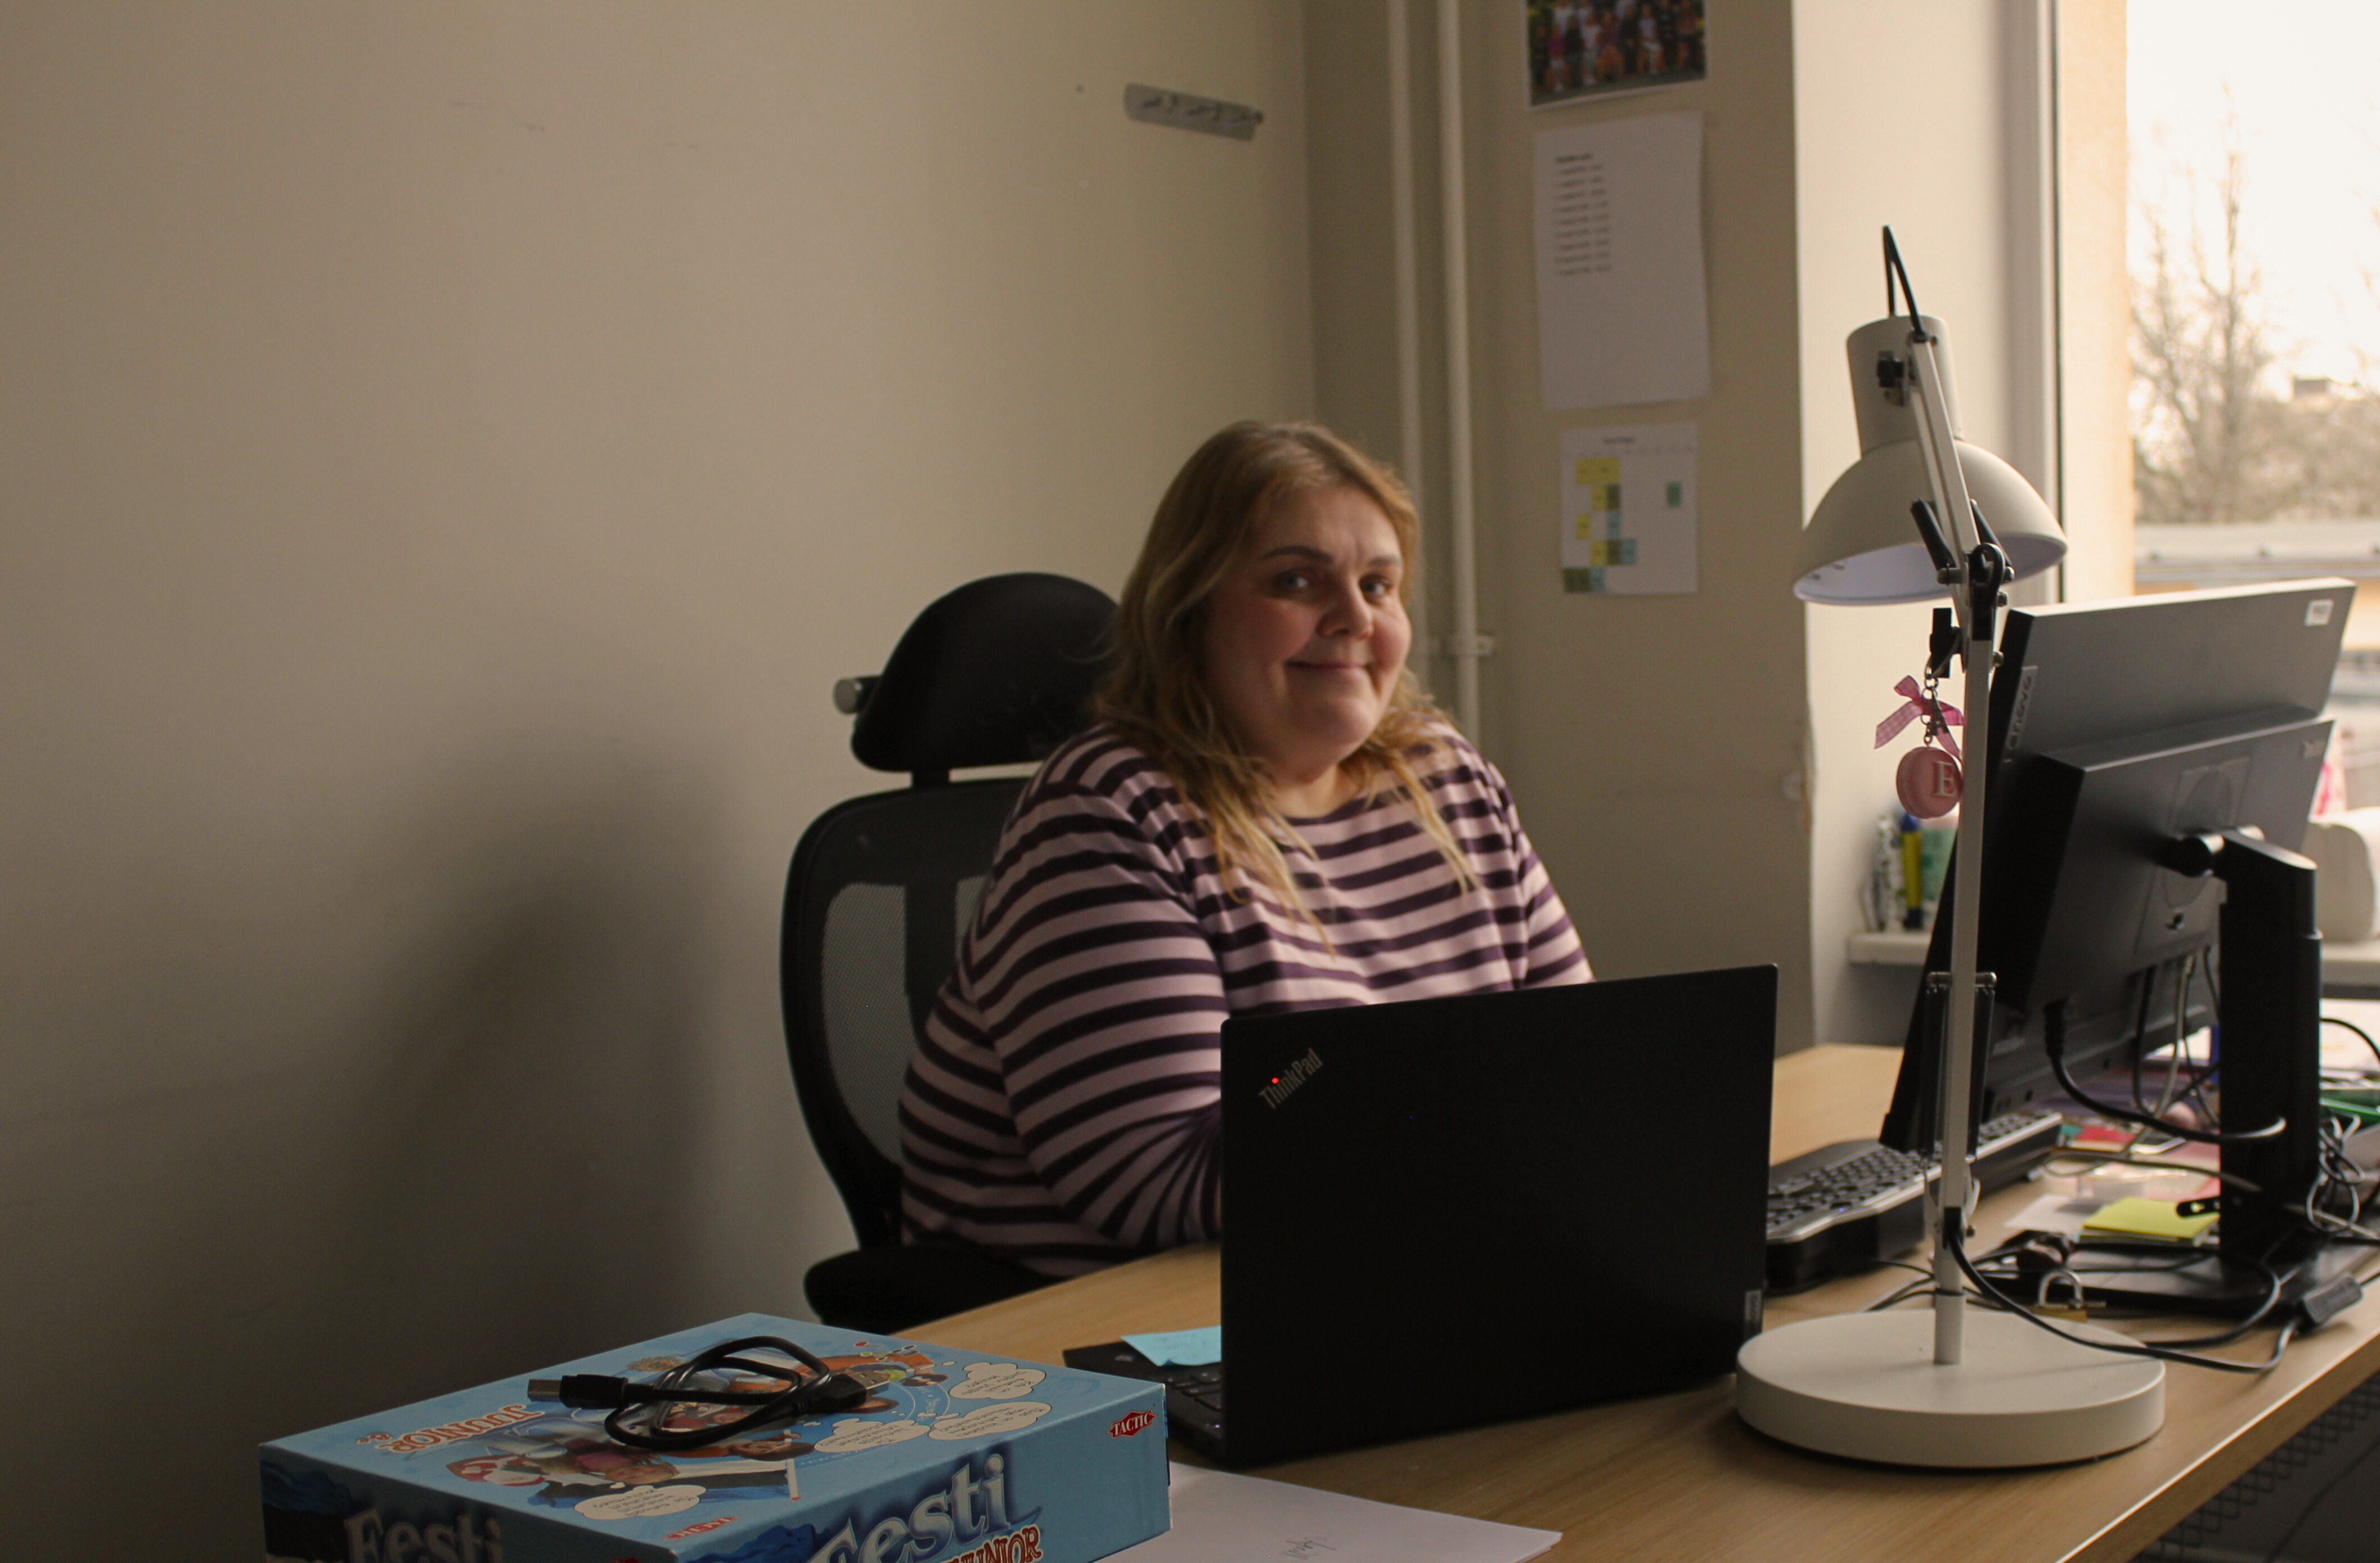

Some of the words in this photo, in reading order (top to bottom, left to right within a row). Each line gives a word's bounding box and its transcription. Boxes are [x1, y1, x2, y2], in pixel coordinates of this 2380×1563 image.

[1933, 761, 1957, 797] E
[1258, 1048, 1323, 1109] ThinkPad
[375, 1404, 545, 1453] JUUNIOR
[1112, 1412, 1152, 1436] TACTIC
